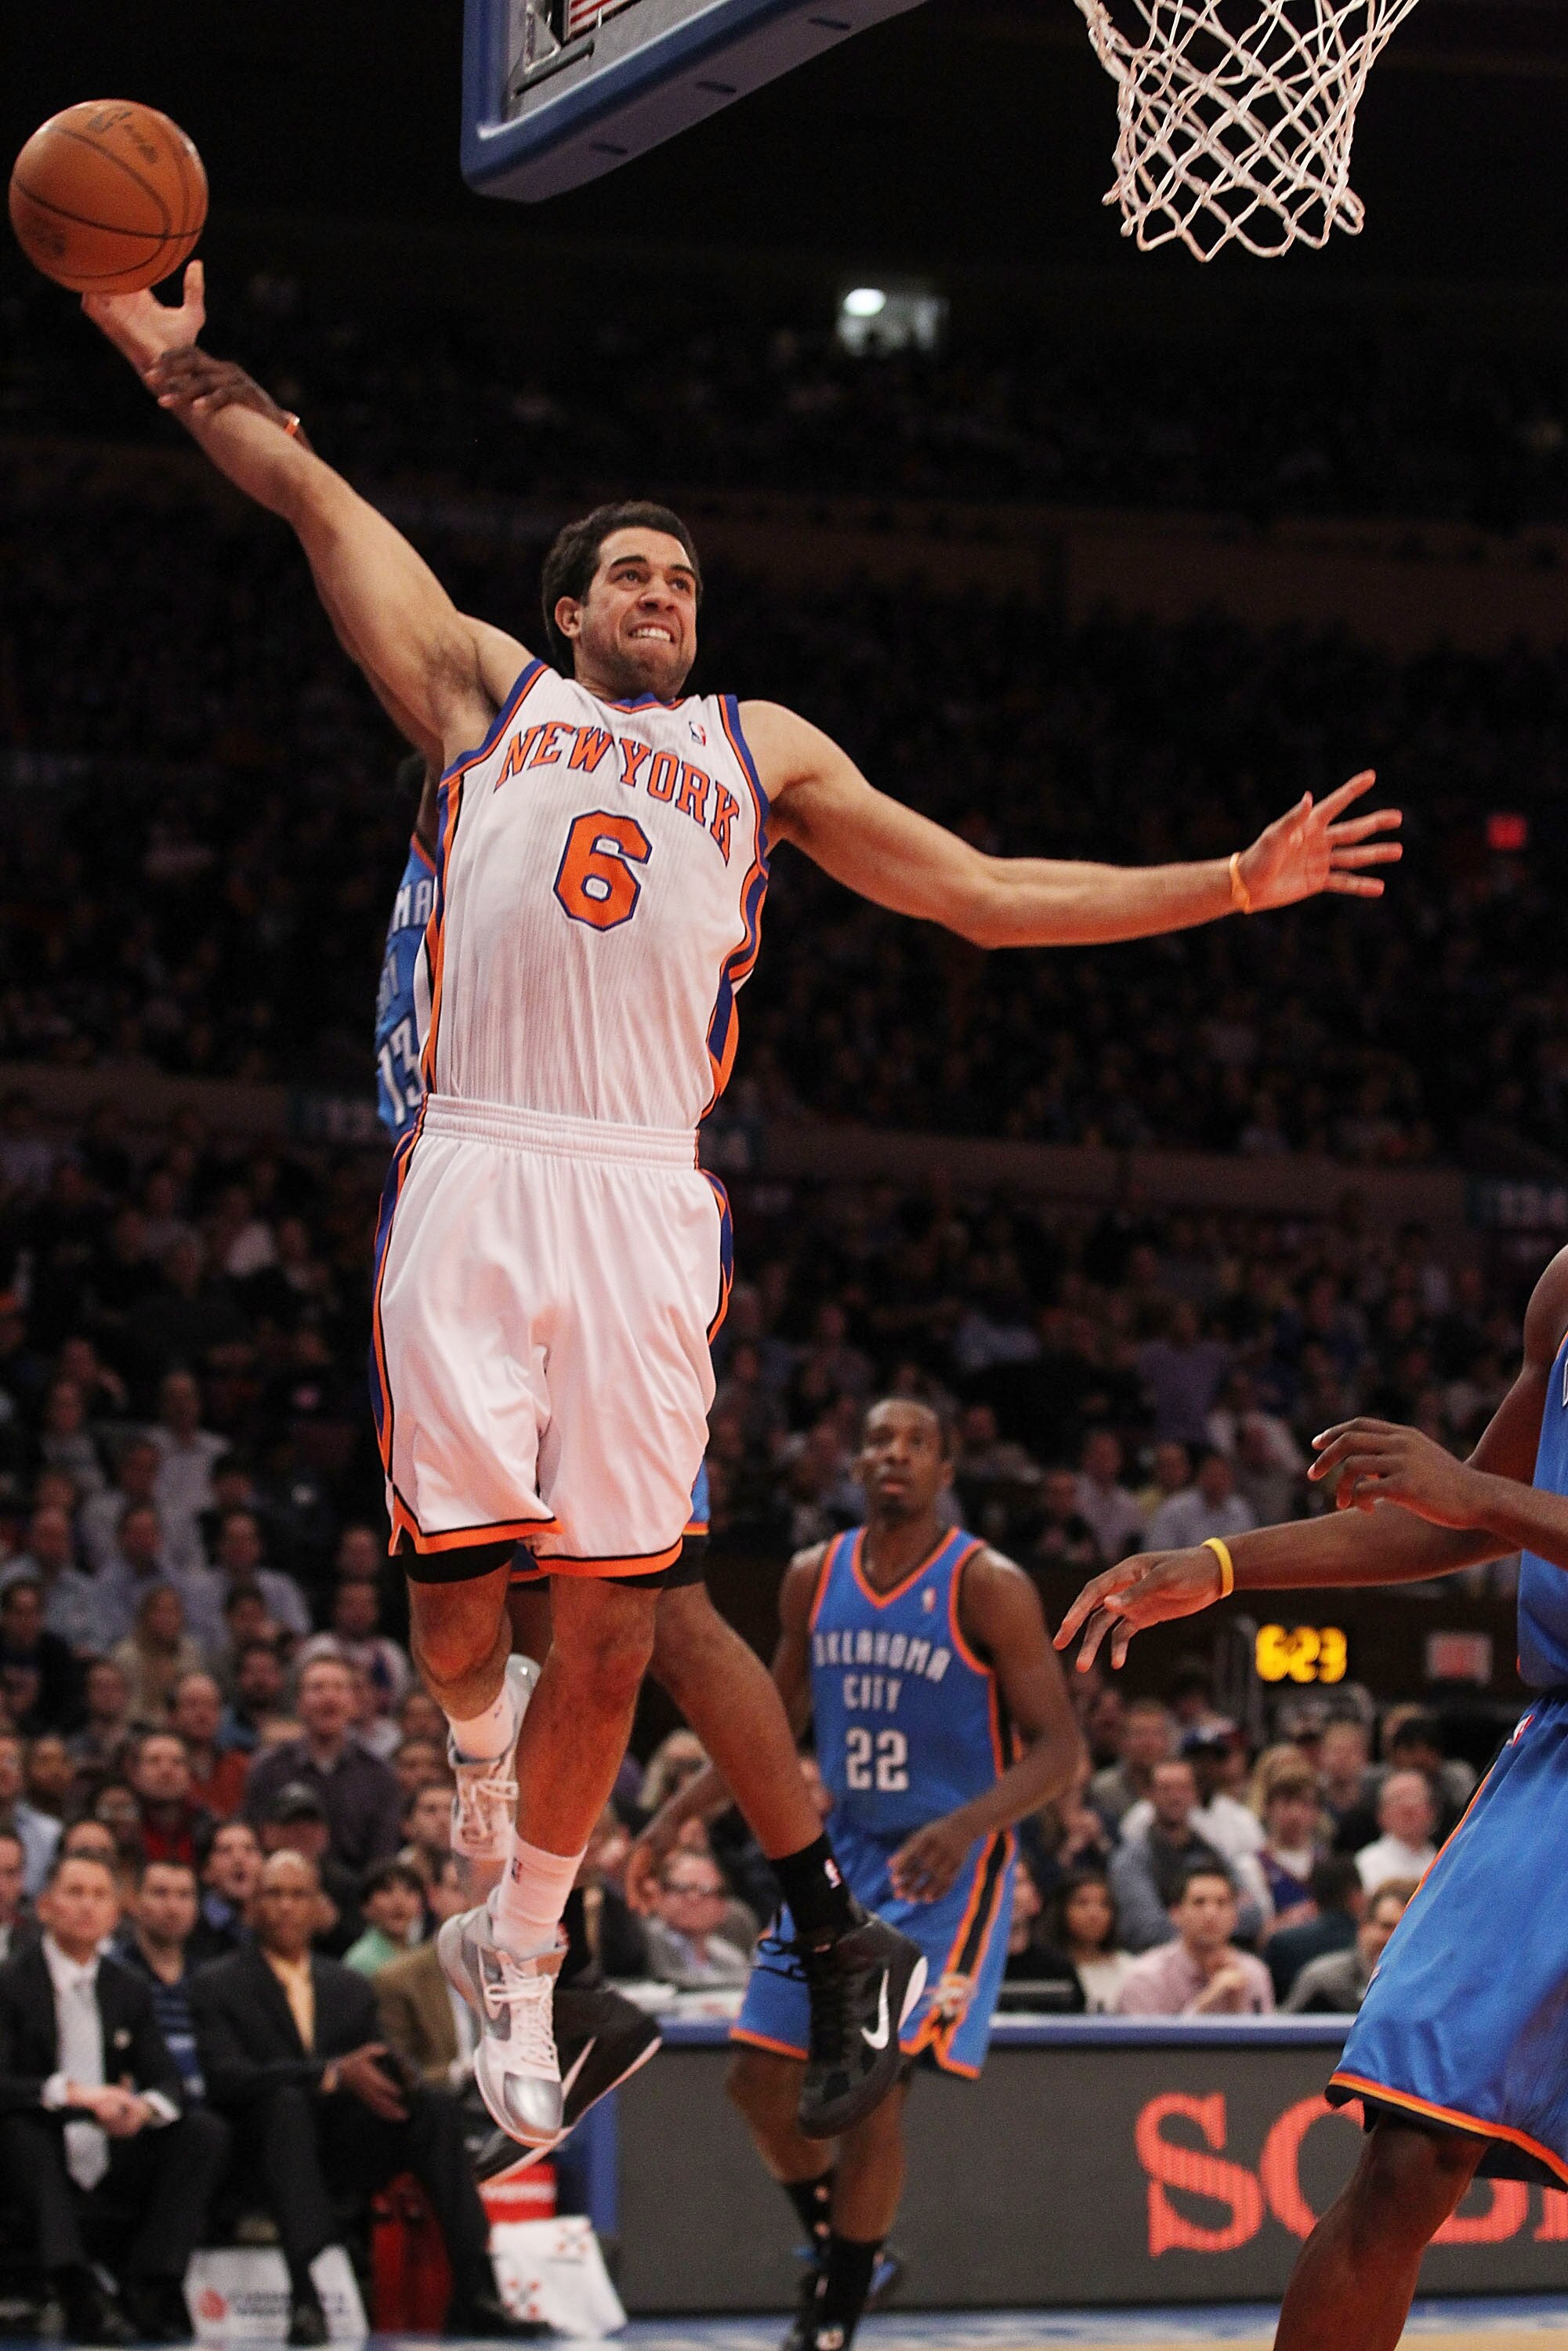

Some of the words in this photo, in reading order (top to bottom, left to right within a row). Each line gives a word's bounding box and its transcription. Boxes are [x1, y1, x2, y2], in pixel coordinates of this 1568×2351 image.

[493, 721, 617, 794] NEW
[618, 737, 741, 868] YORK
[553, 810, 653, 932] 6
[842, 1674, 902, 1712] CITY
[846, 1727, 909, 1791] 22
